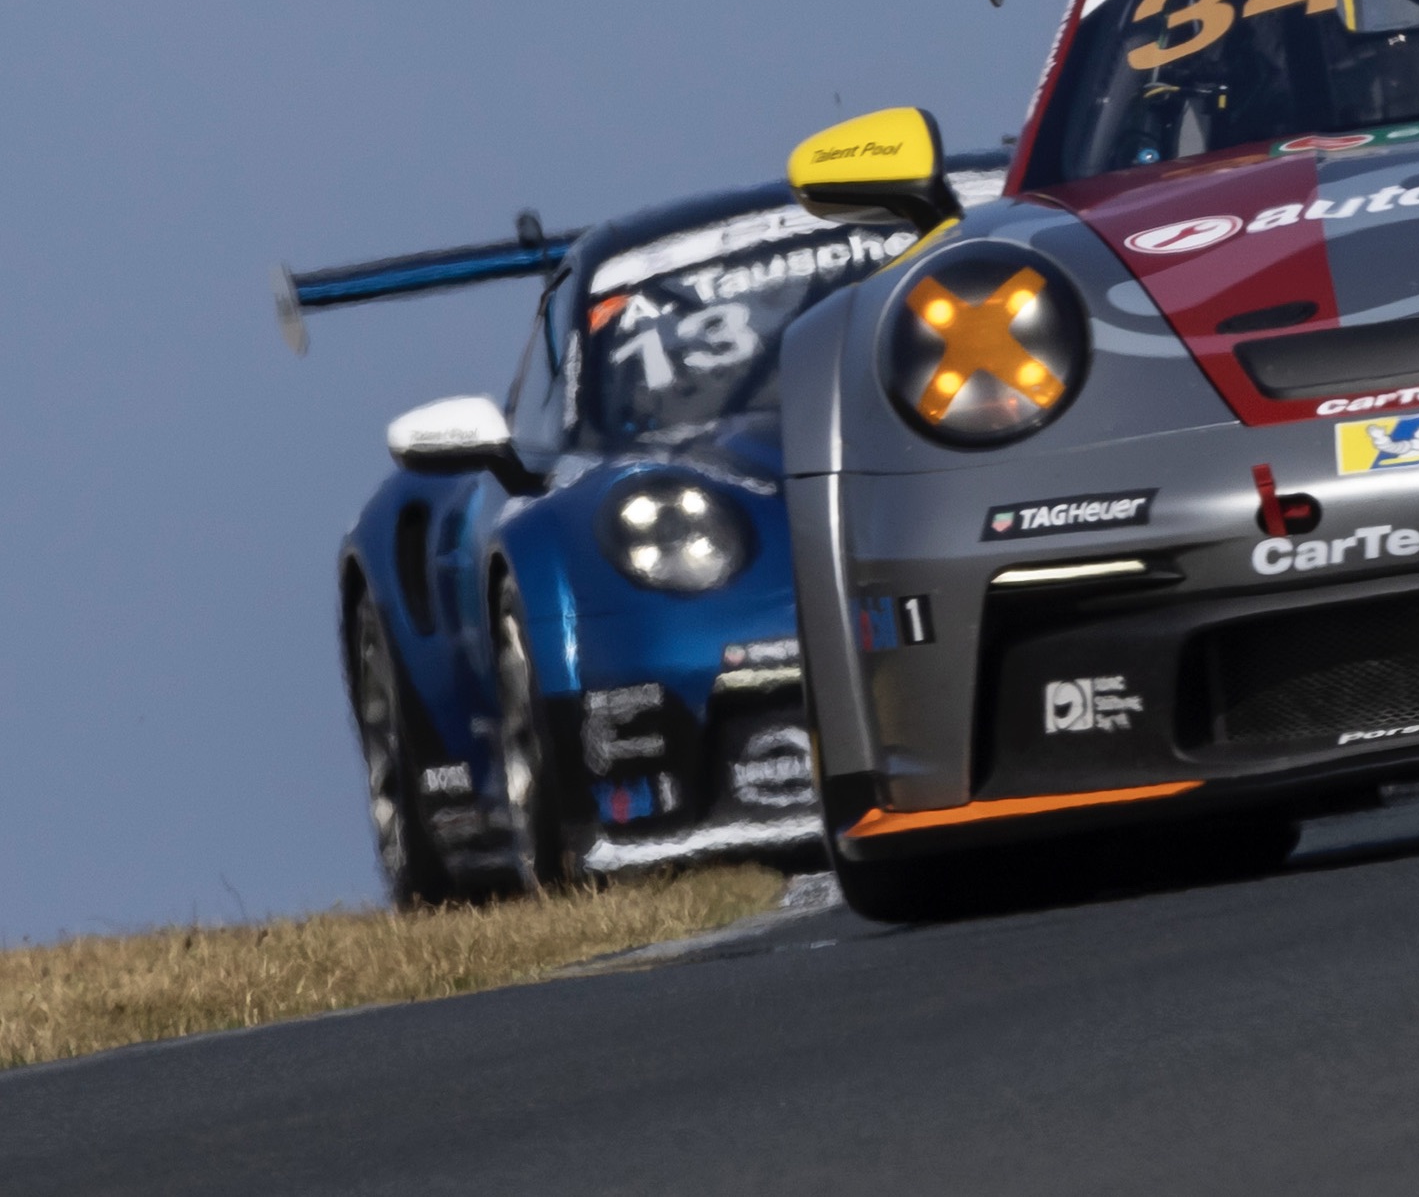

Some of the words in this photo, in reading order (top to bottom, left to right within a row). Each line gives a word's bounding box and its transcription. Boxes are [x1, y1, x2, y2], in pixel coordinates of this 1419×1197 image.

[810, 145, 859, 164] Talent
[860, 141, 904, 157] Pool
[609, 302, 759, 390] 13
[905, 598, 924, 642] 1
